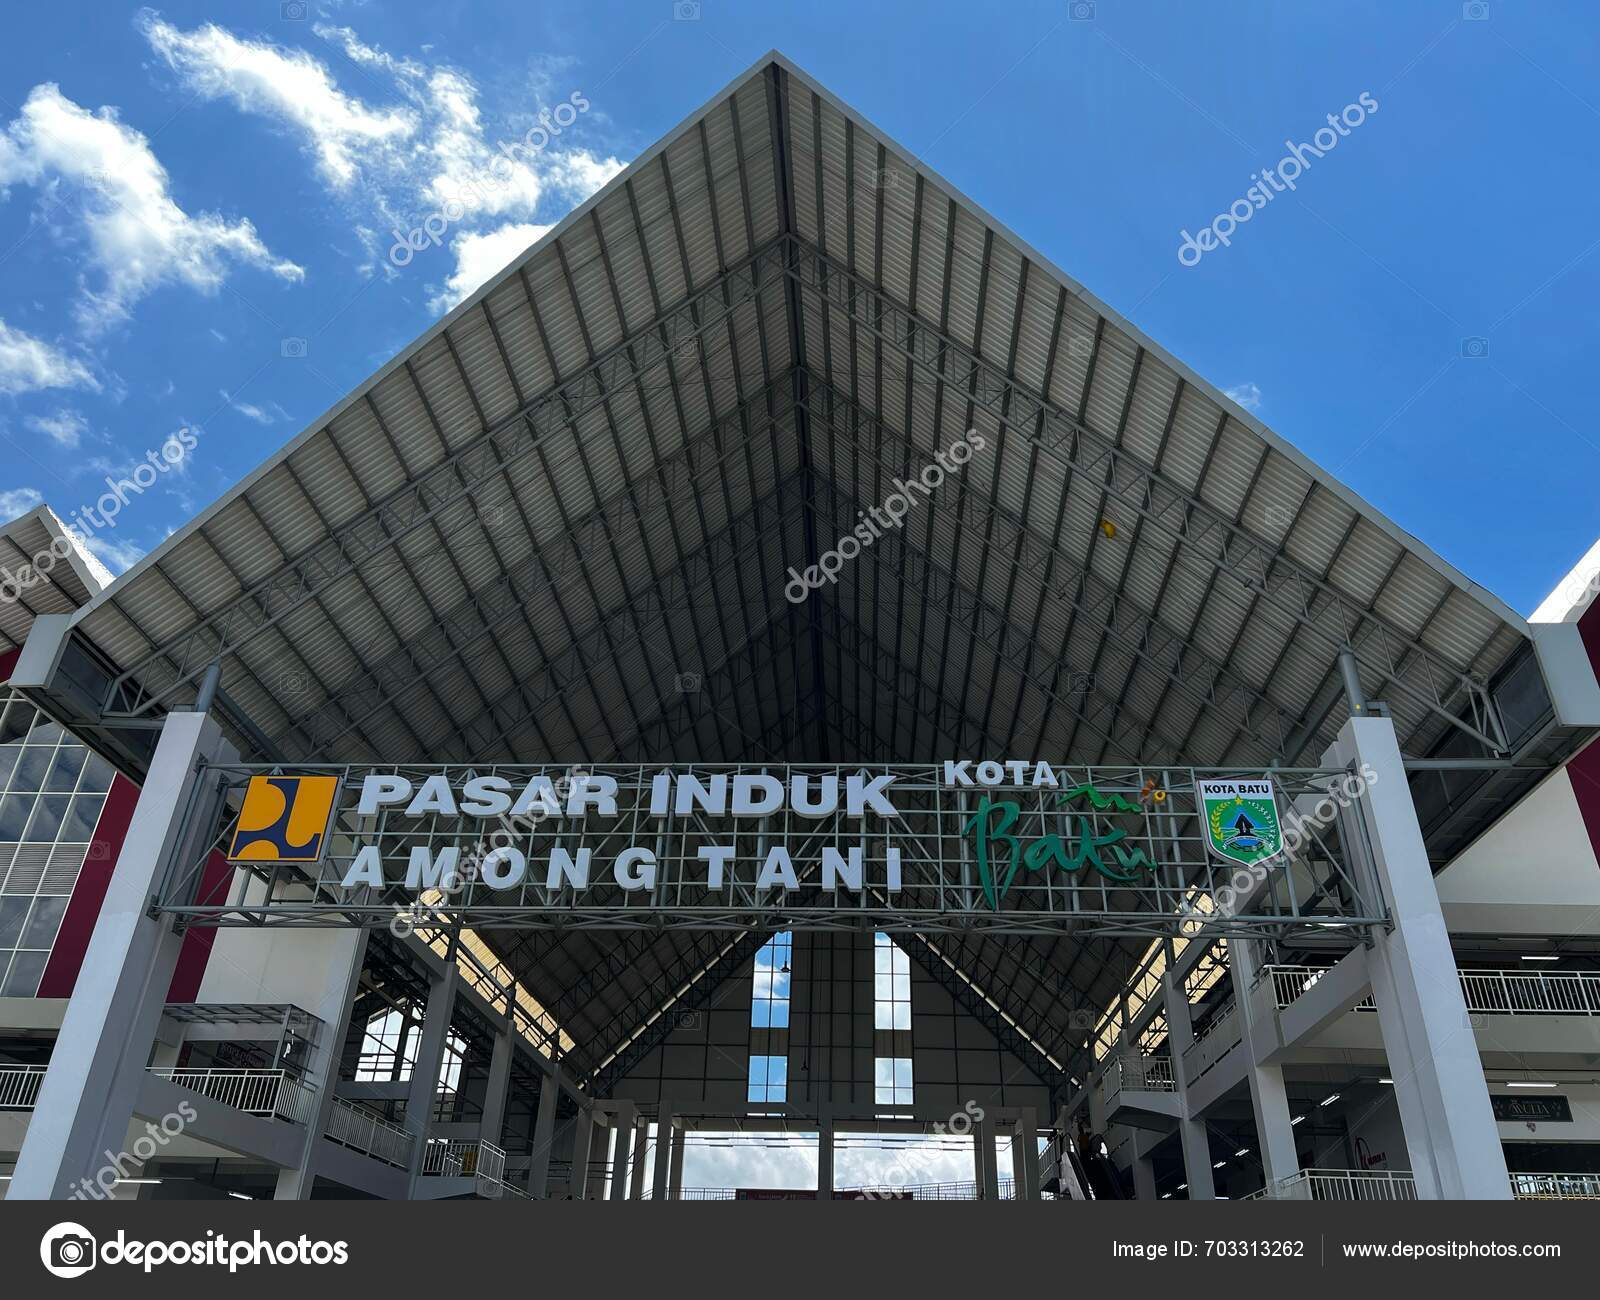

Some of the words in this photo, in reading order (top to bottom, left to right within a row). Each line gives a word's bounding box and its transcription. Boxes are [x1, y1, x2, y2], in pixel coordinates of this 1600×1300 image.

[357, 774, 619, 819] PASAR
[649, 774, 899, 819] INDUK
[944, 760, 1059, 789] KOTA
[1204, 784, 1236, 794] KOTA
[1238, 784, 1270, 794] BATU
[341, 846, 658, 892] AMONG
[698, 846, 902, 893] TANI
[962, 796, 1158, 912] Batu
